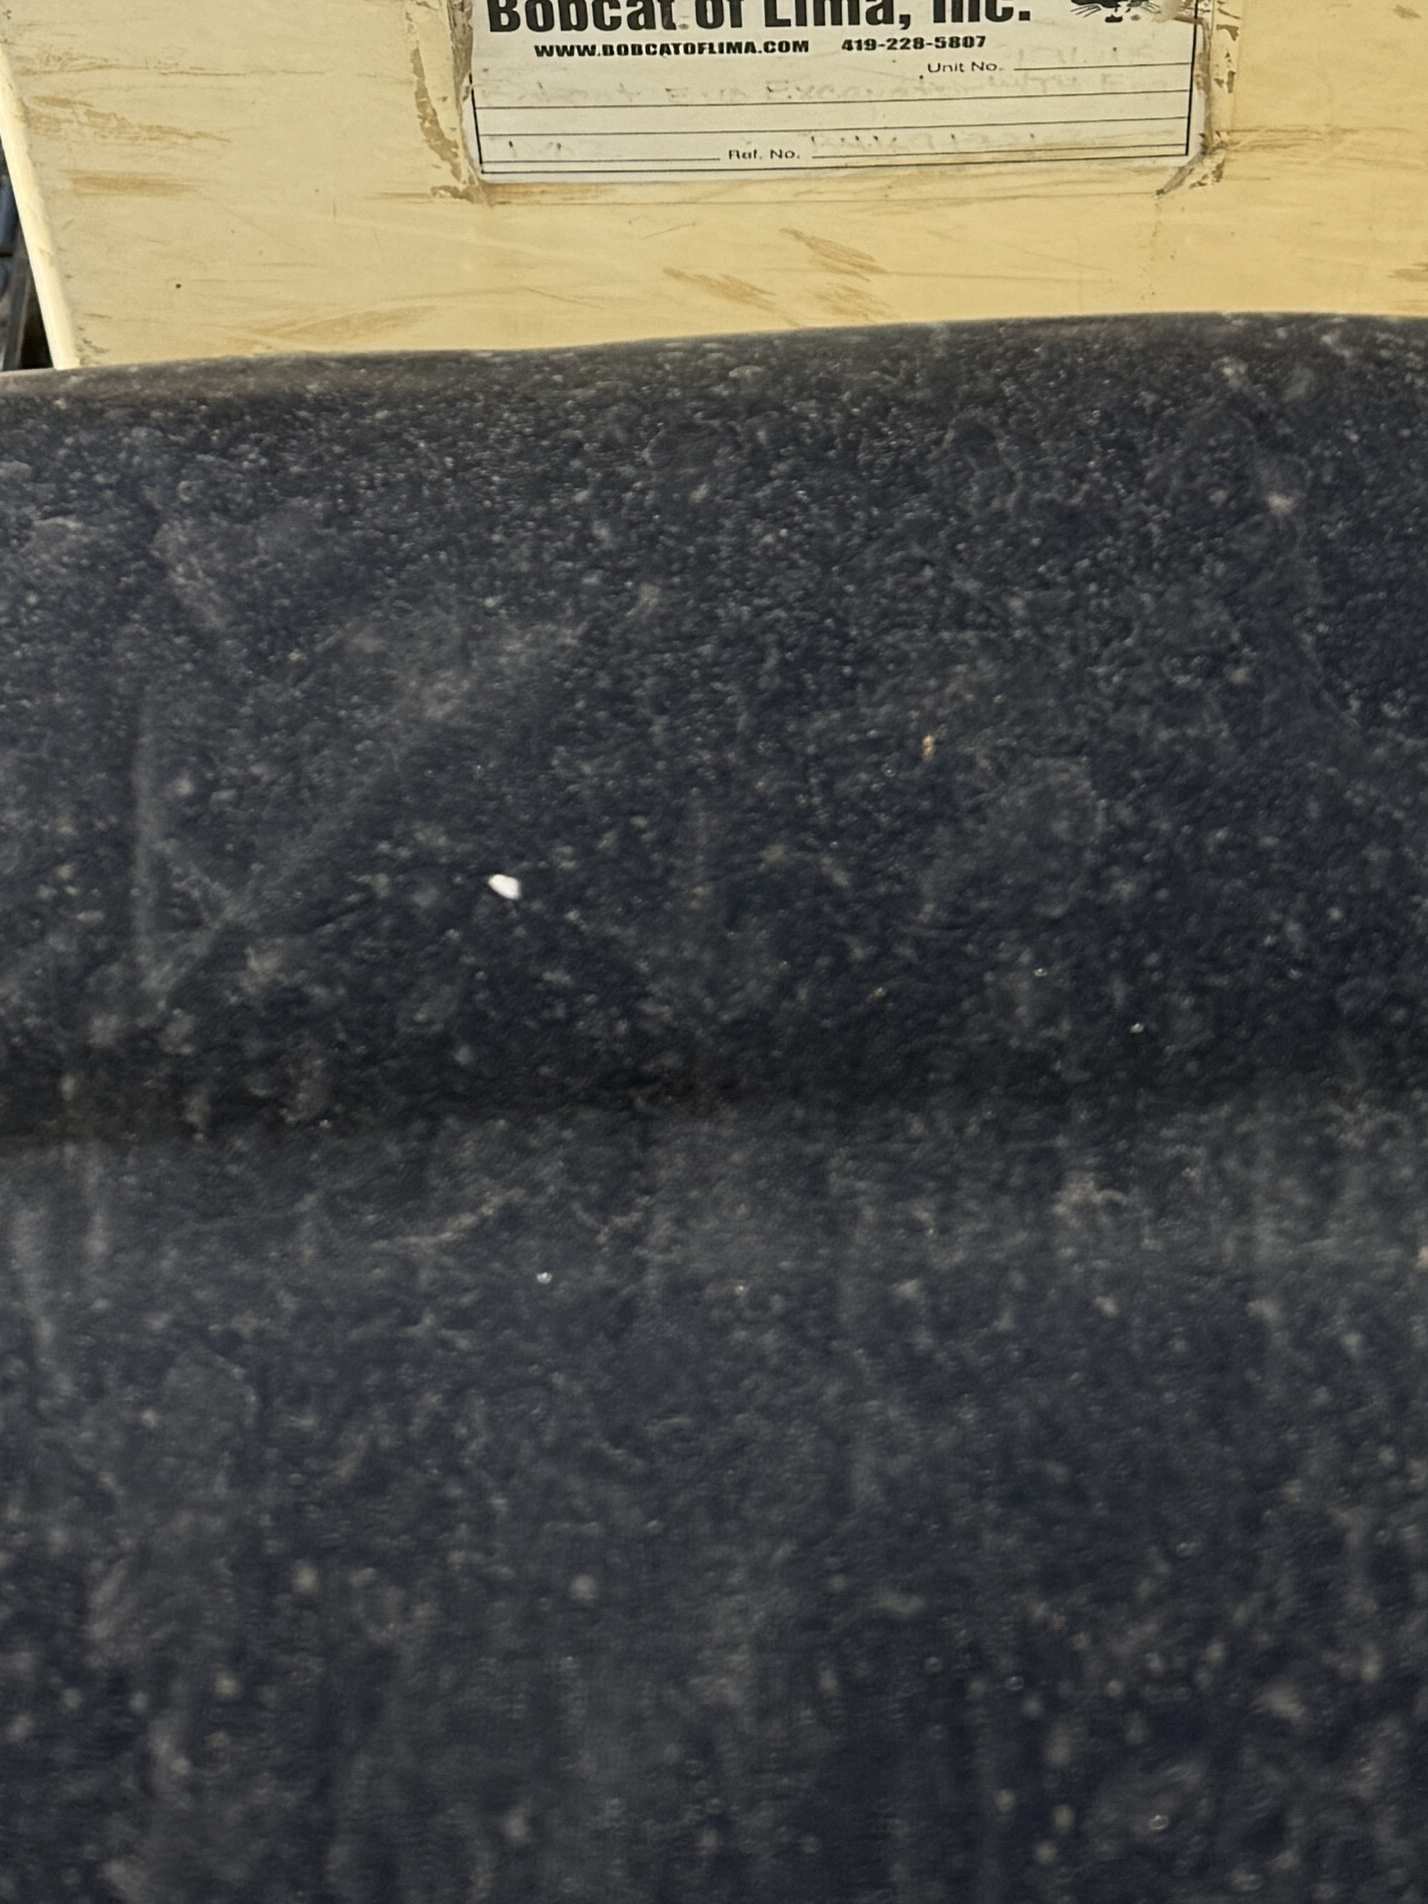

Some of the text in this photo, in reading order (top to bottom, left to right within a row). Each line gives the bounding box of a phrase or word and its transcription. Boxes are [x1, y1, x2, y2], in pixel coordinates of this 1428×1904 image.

[533, 35, 987, 57] WWW.BOBCATOFLIMA.COM 419-228-5807
[927, 61, 1004, 74] Unit No.
[770, 148, 802, 161] No.
